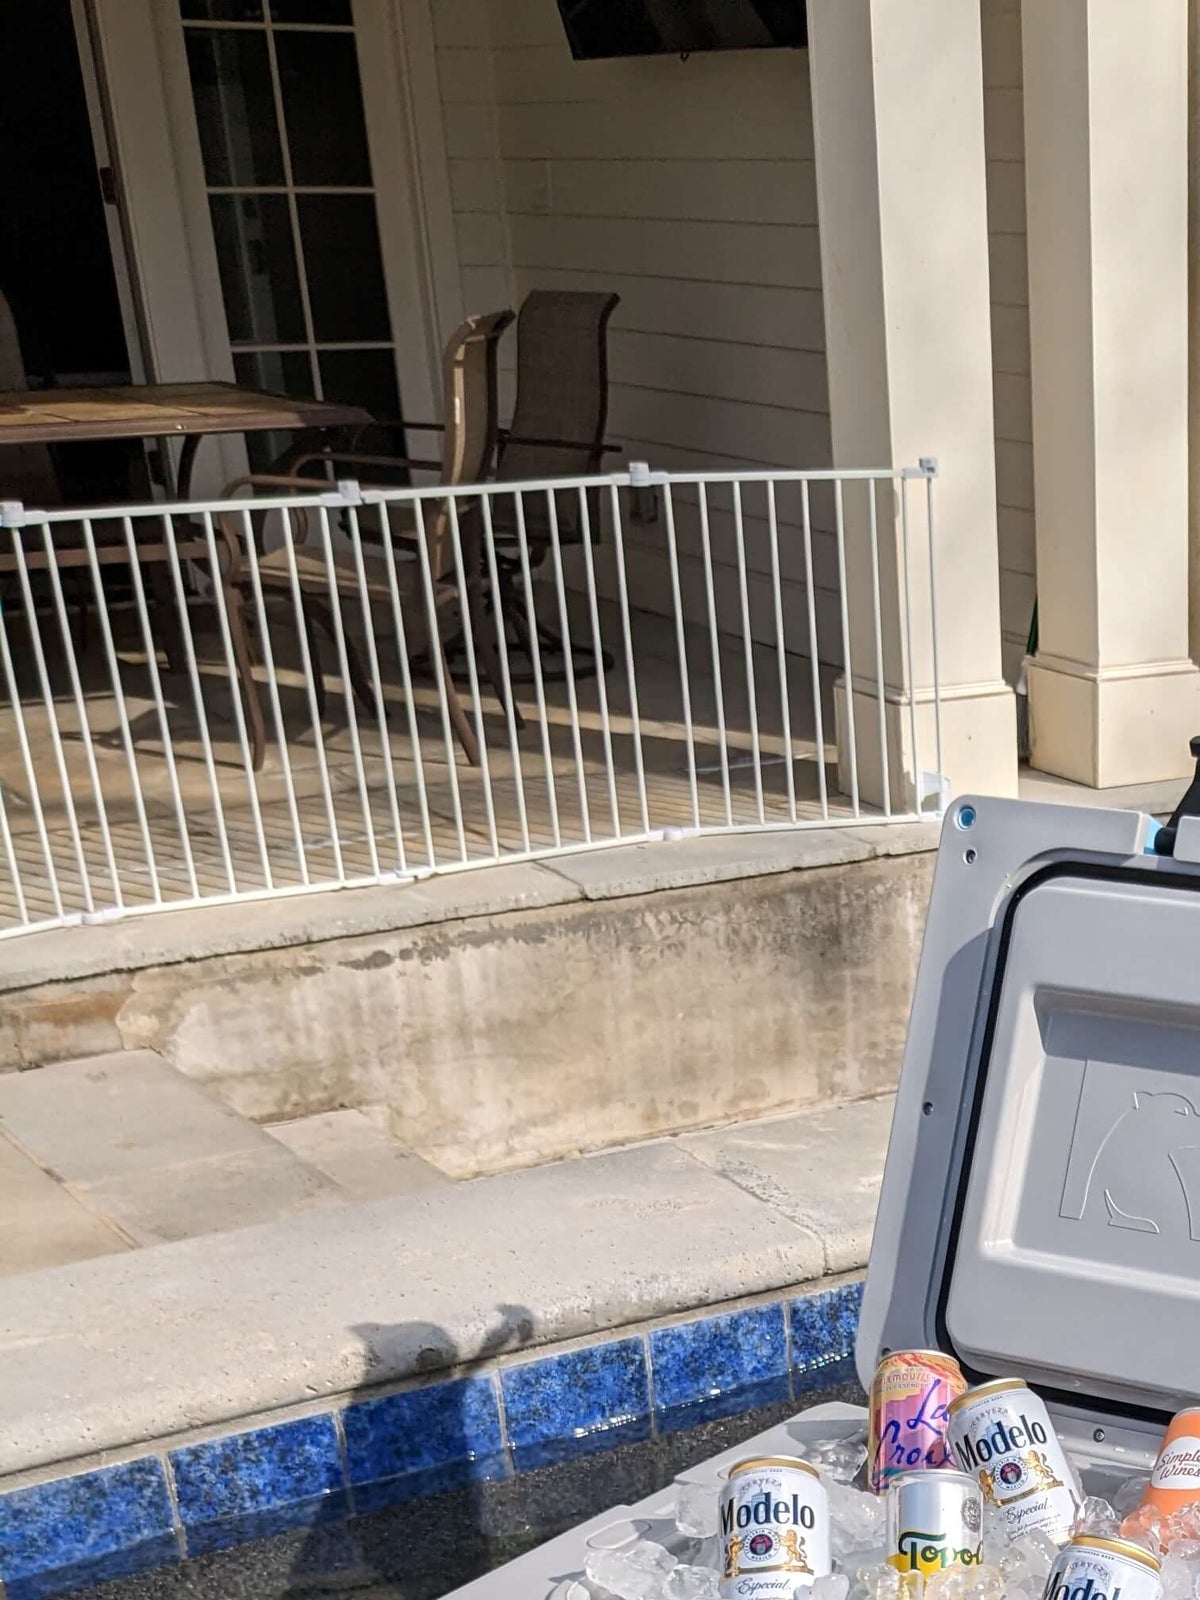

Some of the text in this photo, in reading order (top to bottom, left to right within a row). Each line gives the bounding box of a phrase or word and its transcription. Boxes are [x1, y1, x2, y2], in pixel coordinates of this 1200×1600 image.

[907, 1379, 948, 1435] La
[955, 1414, 1047, 1473] Modelo
[1160, 1465, 1200, 1480] Wines
[721, 1492, 815, 1536] Modelo
[1006, 1497, 1048, 1524] Especial
[898, 1531, 973, 1570] Topo
[736, 1577, 789, 1595] Especial
